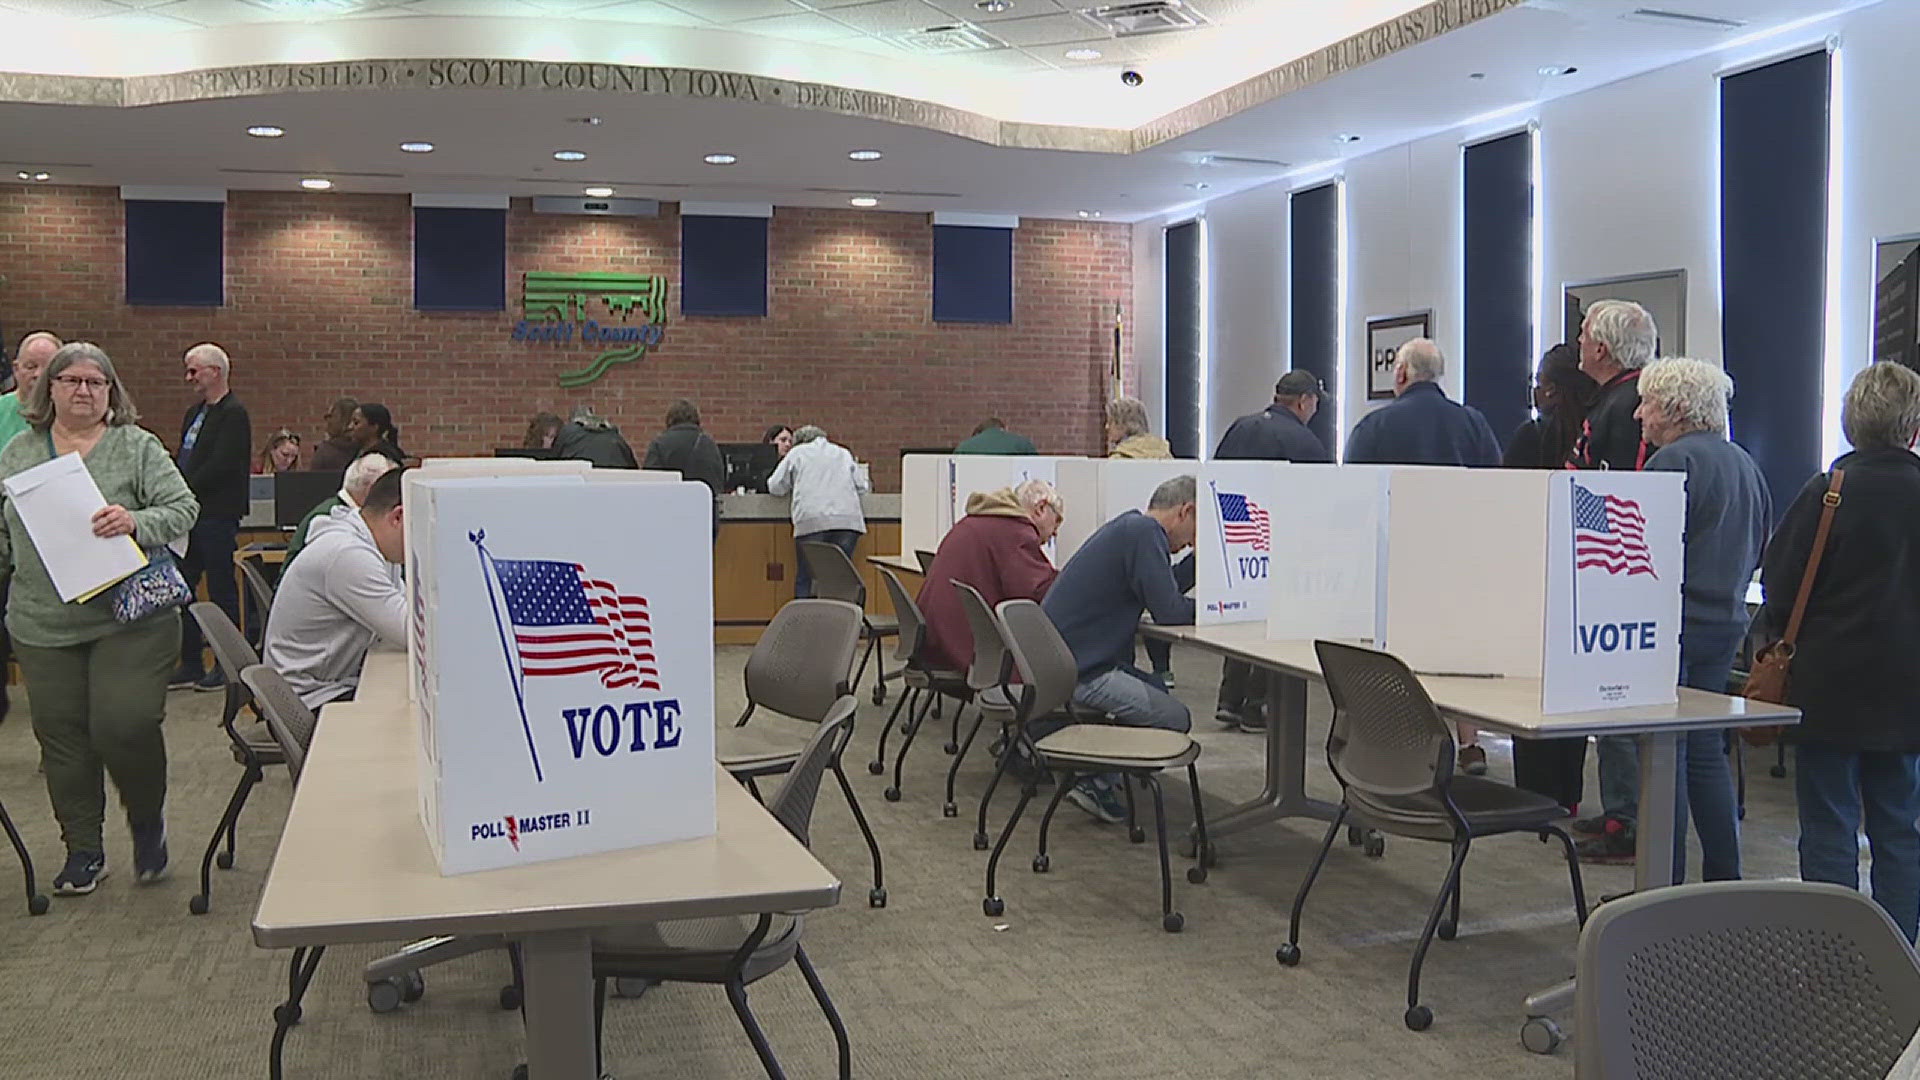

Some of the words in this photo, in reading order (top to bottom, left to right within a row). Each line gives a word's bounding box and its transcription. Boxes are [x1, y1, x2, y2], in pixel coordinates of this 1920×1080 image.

[1325, 36, 1365, 74] BLUE
[1367, 13, 1423, 59] GRASS
[1433, 0, 1519, 33] BUFF
[174, 65, 388, 98] STABLISHED
[428, 59, 534, 87] SCOTT
[541, 63, 677, 95] COUNTY
[687, 71, 760, 102] IOWA
[512, 320, 573, 342] Scott
[582, 319, 663, 345] County
[1238, 556, 1269, 580] VOT
[1579, 621, 1656, 653] VOTE
[562, 699, 683, 760] VOTE
[471, 821, 506, 841] POLL
[519, 812, 571, 833] MASTER
[577, 809, 590, 826] II
